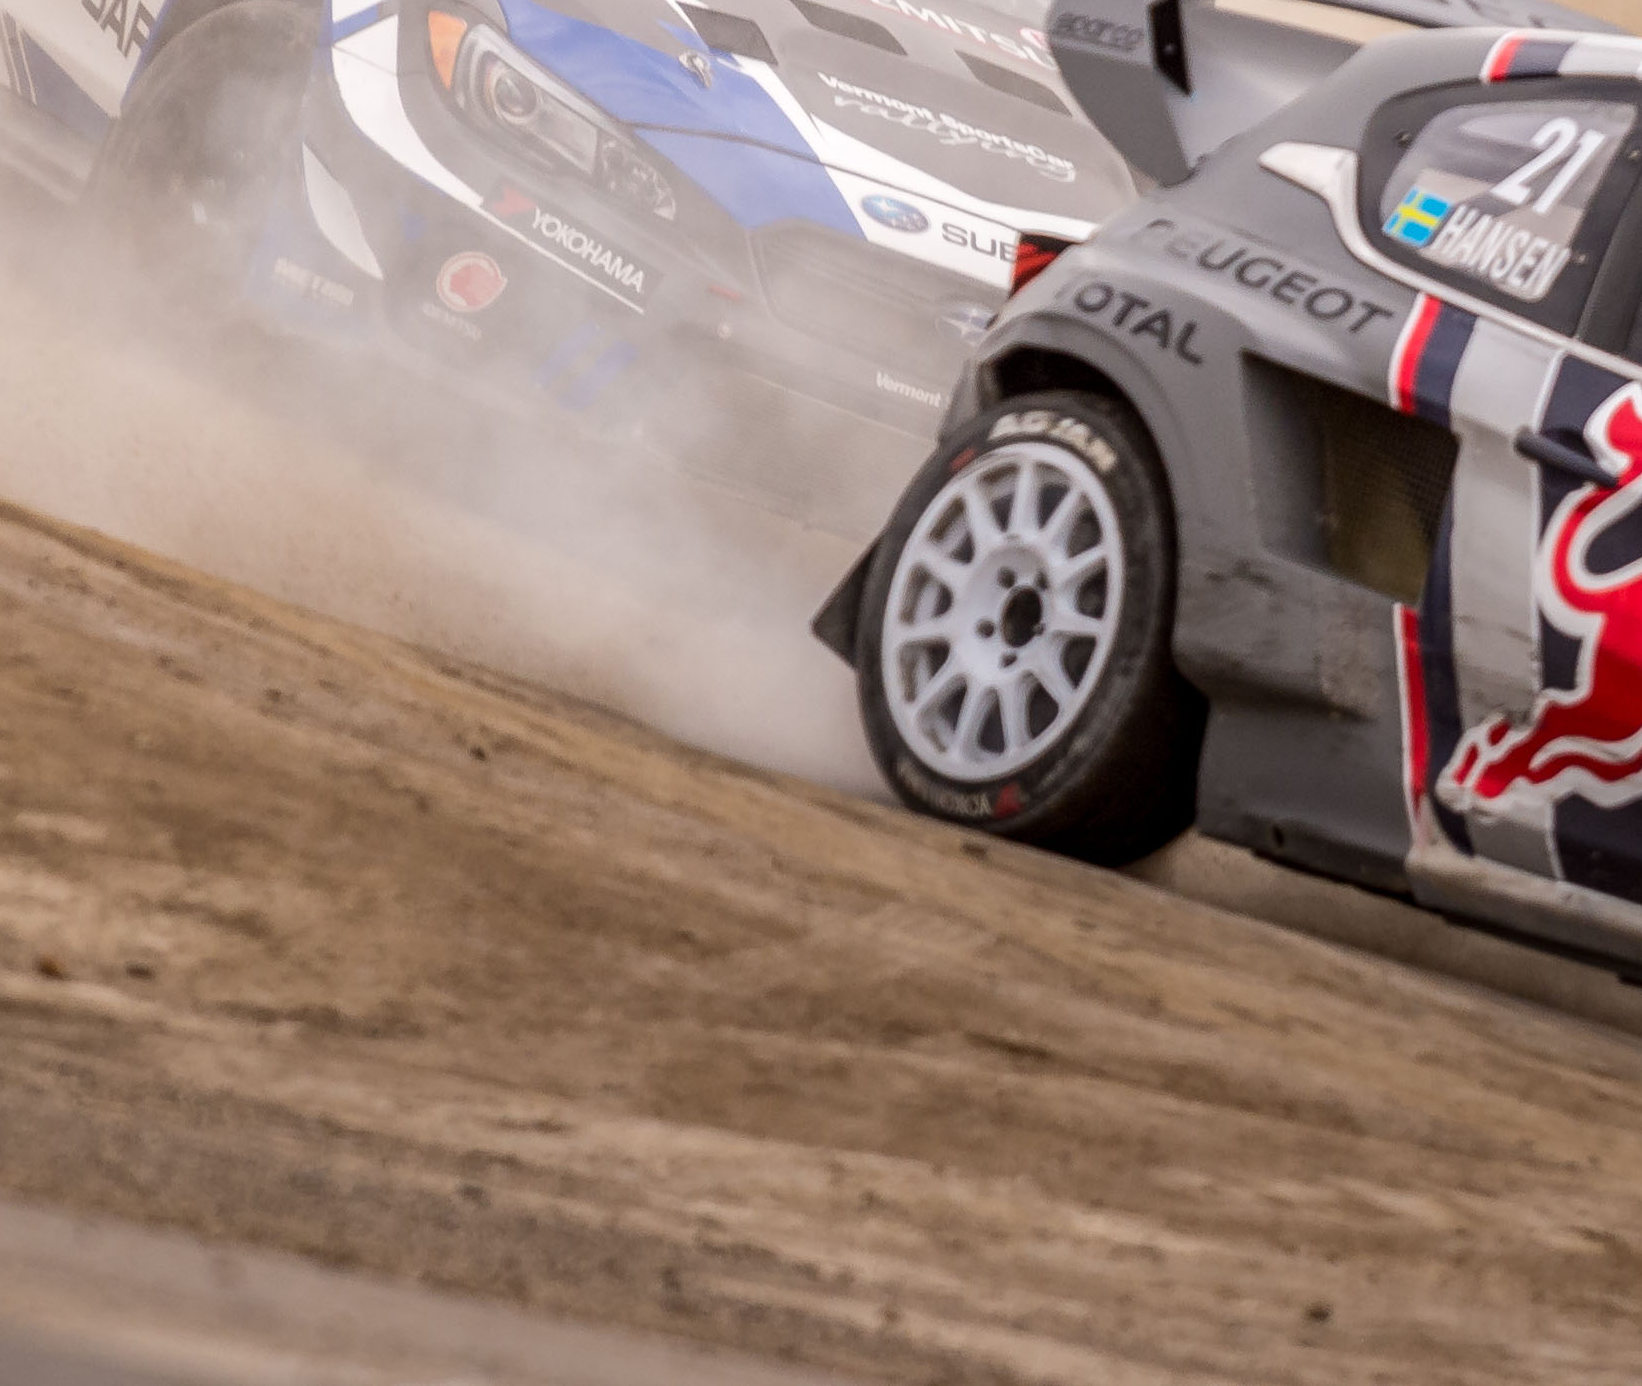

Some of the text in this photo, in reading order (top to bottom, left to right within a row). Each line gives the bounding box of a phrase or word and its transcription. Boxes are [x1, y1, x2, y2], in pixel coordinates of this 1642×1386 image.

[818, 71, 1075, 169] Vermont SportsCar
[1490, 117, 1606, 214] 21
[531, 205, 646, 294] YOKOHAMA
[1430, 204, 1572, 297] HANSEN
[875, 370, 942, 407] Vermont
